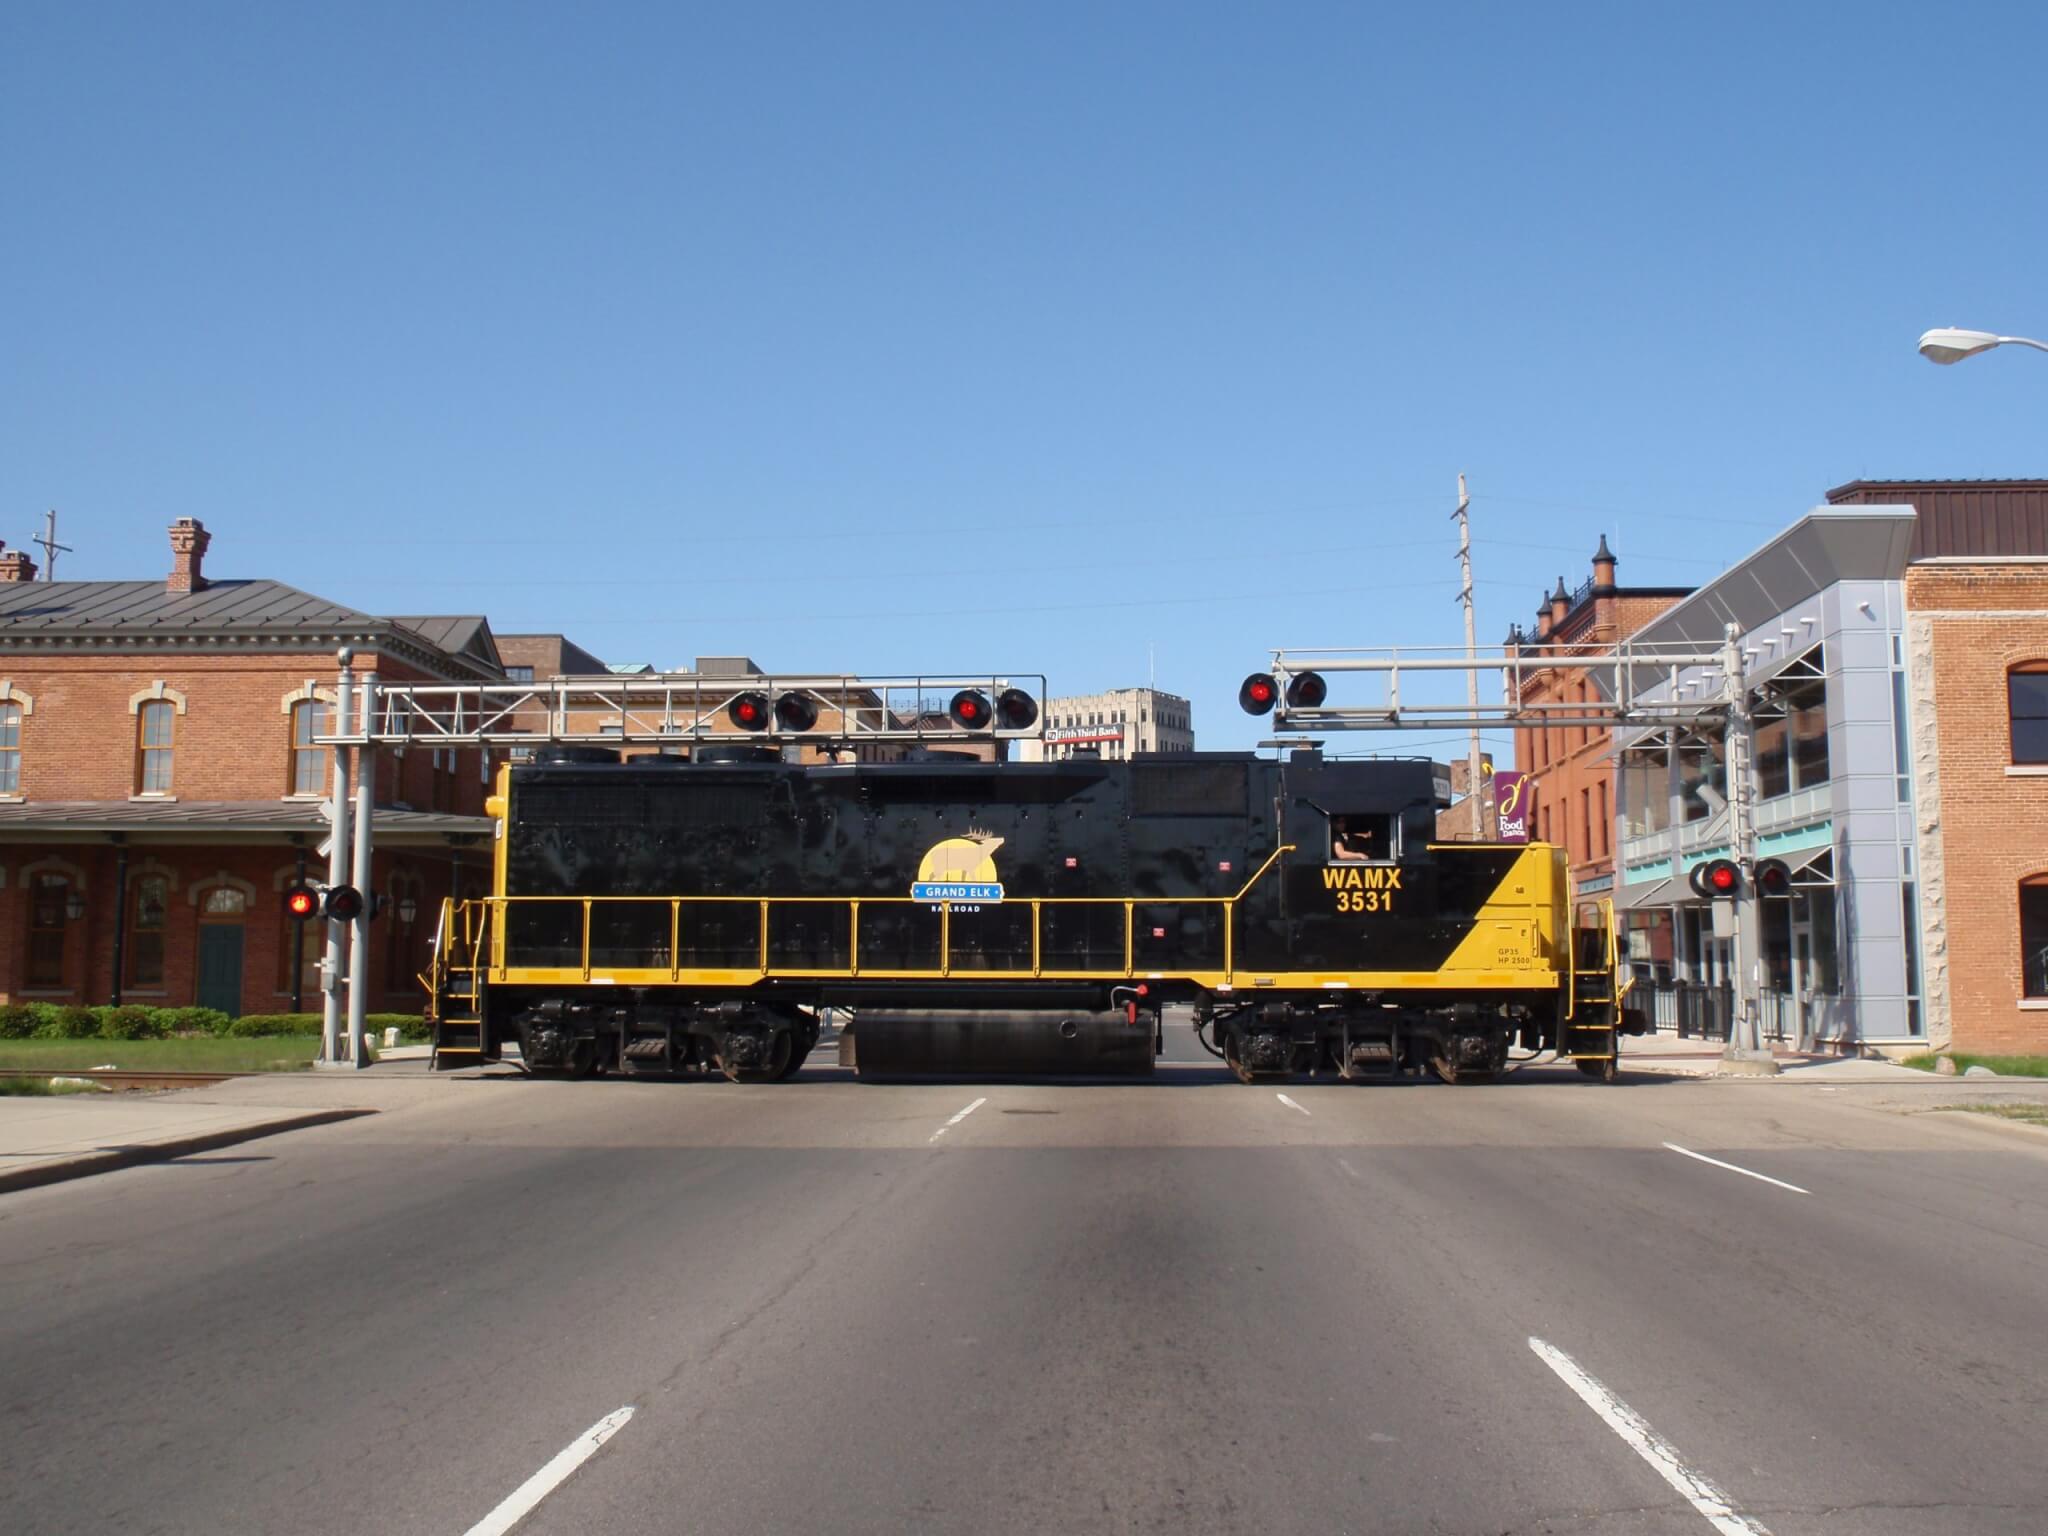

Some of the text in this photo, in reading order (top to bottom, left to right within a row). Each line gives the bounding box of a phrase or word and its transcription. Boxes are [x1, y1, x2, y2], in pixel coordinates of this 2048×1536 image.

[1058, 730, 1077, 739] Fifth
[1077, 728, 1097, 737] Third
[1098, 726, 1118, 736] Bank
[1499, 816, 1523, 831] Food
[1322, 868, 1402, 889] WAMX
[926, 887, 990, 897] GRAND ELK
[1337, 891, 1391, 912] 3531
[931, 905, 980, 913] RALROAD
